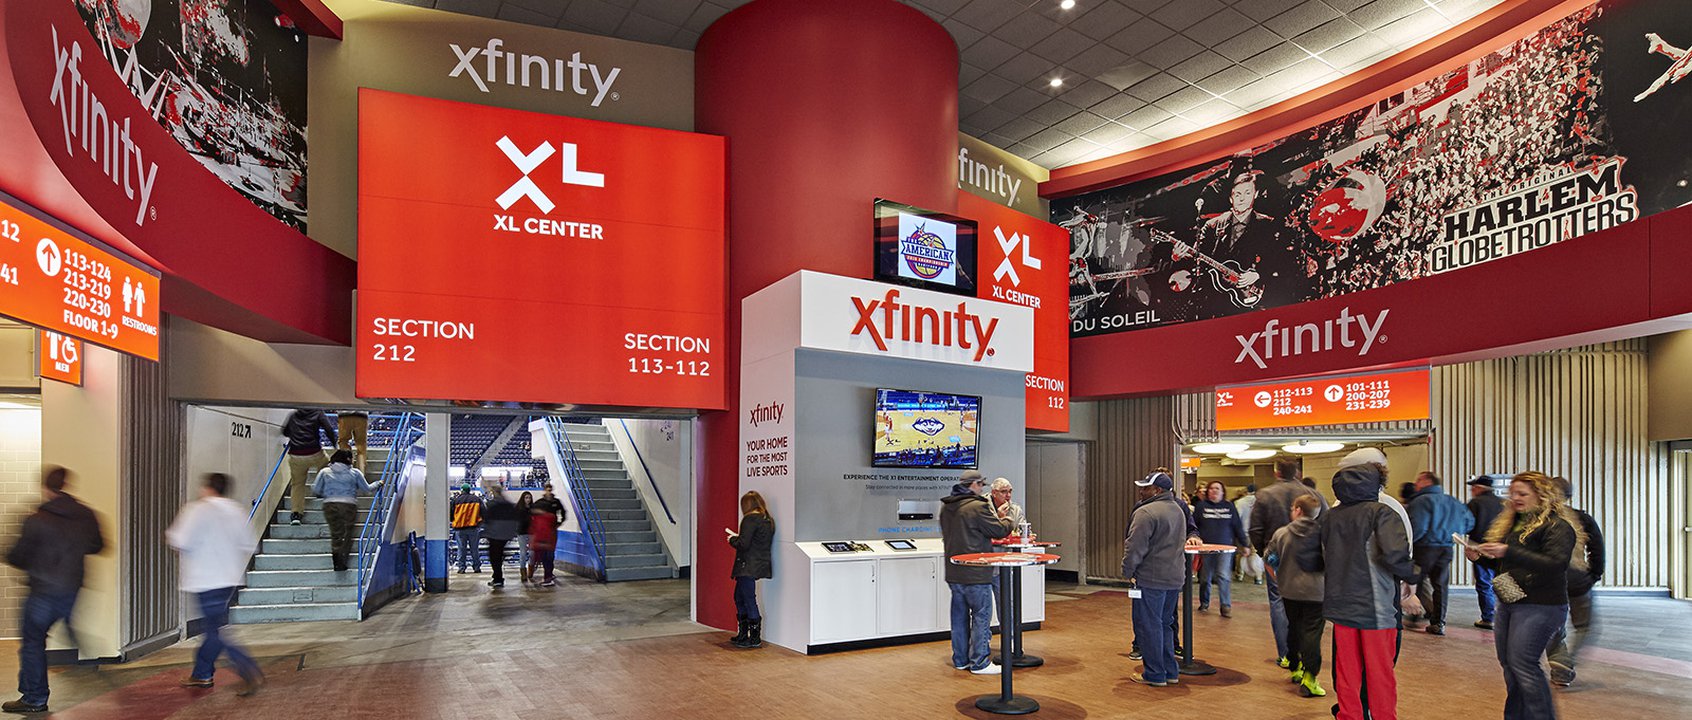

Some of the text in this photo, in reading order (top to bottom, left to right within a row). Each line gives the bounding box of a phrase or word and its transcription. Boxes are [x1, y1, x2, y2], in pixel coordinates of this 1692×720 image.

[449, 38, 621, 107] xfinity
[50, 24, 158, 226] xfinity
[495, 135, 605, 215] XL
[958, 147, 1022, 207] finity
[1483, 166, 1573, 201] THE ORIGINAL
[1444, 163, 1619, 242] HARLEM
[494, 214, 603, 240] XL CENTER
[1431, 192, 1635, 273] GLOBETROTTERS
[905, 243, 950, 261] AMERICAN
[993, 225, 1042, 288] XL
[64, 248, 111, 282] 113-124
[63, 268, 111, 300] 213-219
[63, 287, 111, 318] 220-230
[992, 284, 1041, 309] XL CENTER
[63, 309, 119, 339] FLOOR 1-9
[122, 315, 157, 336] RESTROOMS
[373, 317, 475, 340] SECTION
[850, 289, 1000, 362] xfinity
[1073, 309, 1161, 333] DU SOLEIL
[624, 332, 711, 354] SECTION
[1234, 306, 1390, 369] xfinity
[373, 343, 416, 362] 212
[54, 361, 70, 373] MEN
[628, 357, 711, 377] 113-112
[1025, 374, 1065, 393] SECTION
[1273, 386, 1313, 399] 112-113
[1345, 389, 1390, 401] 200-207
[1346, 380, 1390, 391] 101-111
[750, 400, 785, 427] xfinity
[1048, 396, 1065, 410] 112
[1273, 398, 1291, 407] 212
[1273, 405, 1313, 416] 240-241
[1345, 399, 1391, 411] 231-239
[231, 421, 244, 438] 212
[746, 436, 788, 452] YOUR HOME
[746, 451, 788, 464] FOR THE MOST
[746, 464, 788, 477] LIVE SPORTS
